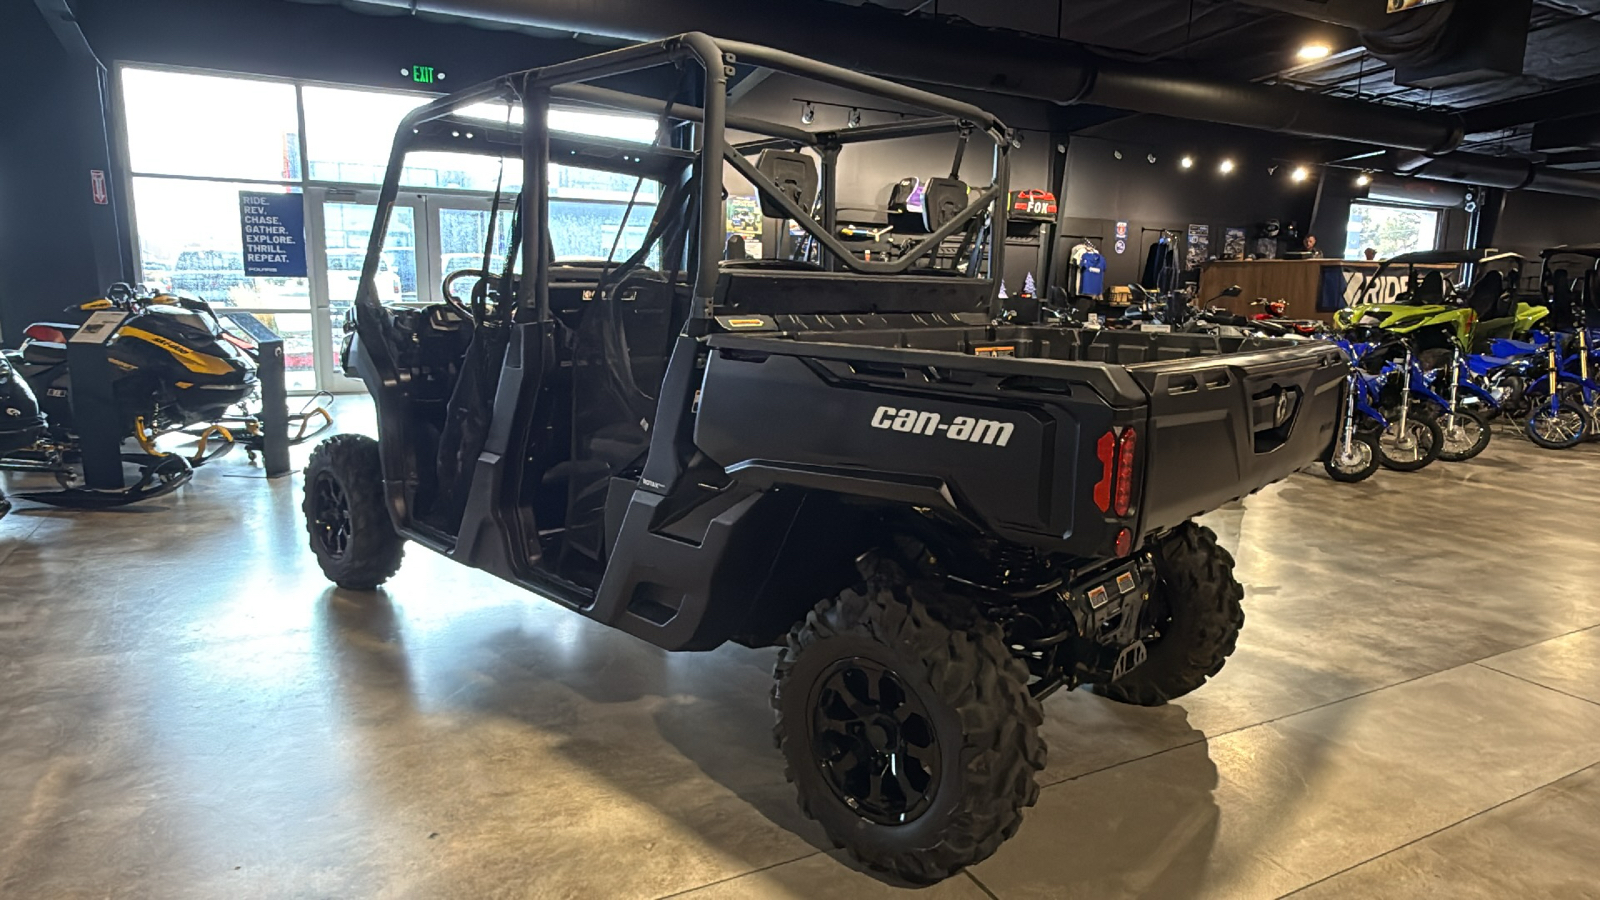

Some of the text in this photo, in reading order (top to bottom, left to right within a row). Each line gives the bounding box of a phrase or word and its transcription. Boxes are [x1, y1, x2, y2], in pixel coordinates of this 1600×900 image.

[413, 65, 434, 83] EXIT
[244, 206, 267, 215] REV.
[1027, 202, 1049, 214] FOX
[245, 216, 282, 225] CHASE.
[245, 225, 289, 235] GATHER.
[246, 235, 296, 244] EXPLORE.
[247, 244, 286, 253] THRILL.
[247, 254, 290, 263] REPEAT.
[871, 405, 1014, 447] can-am
